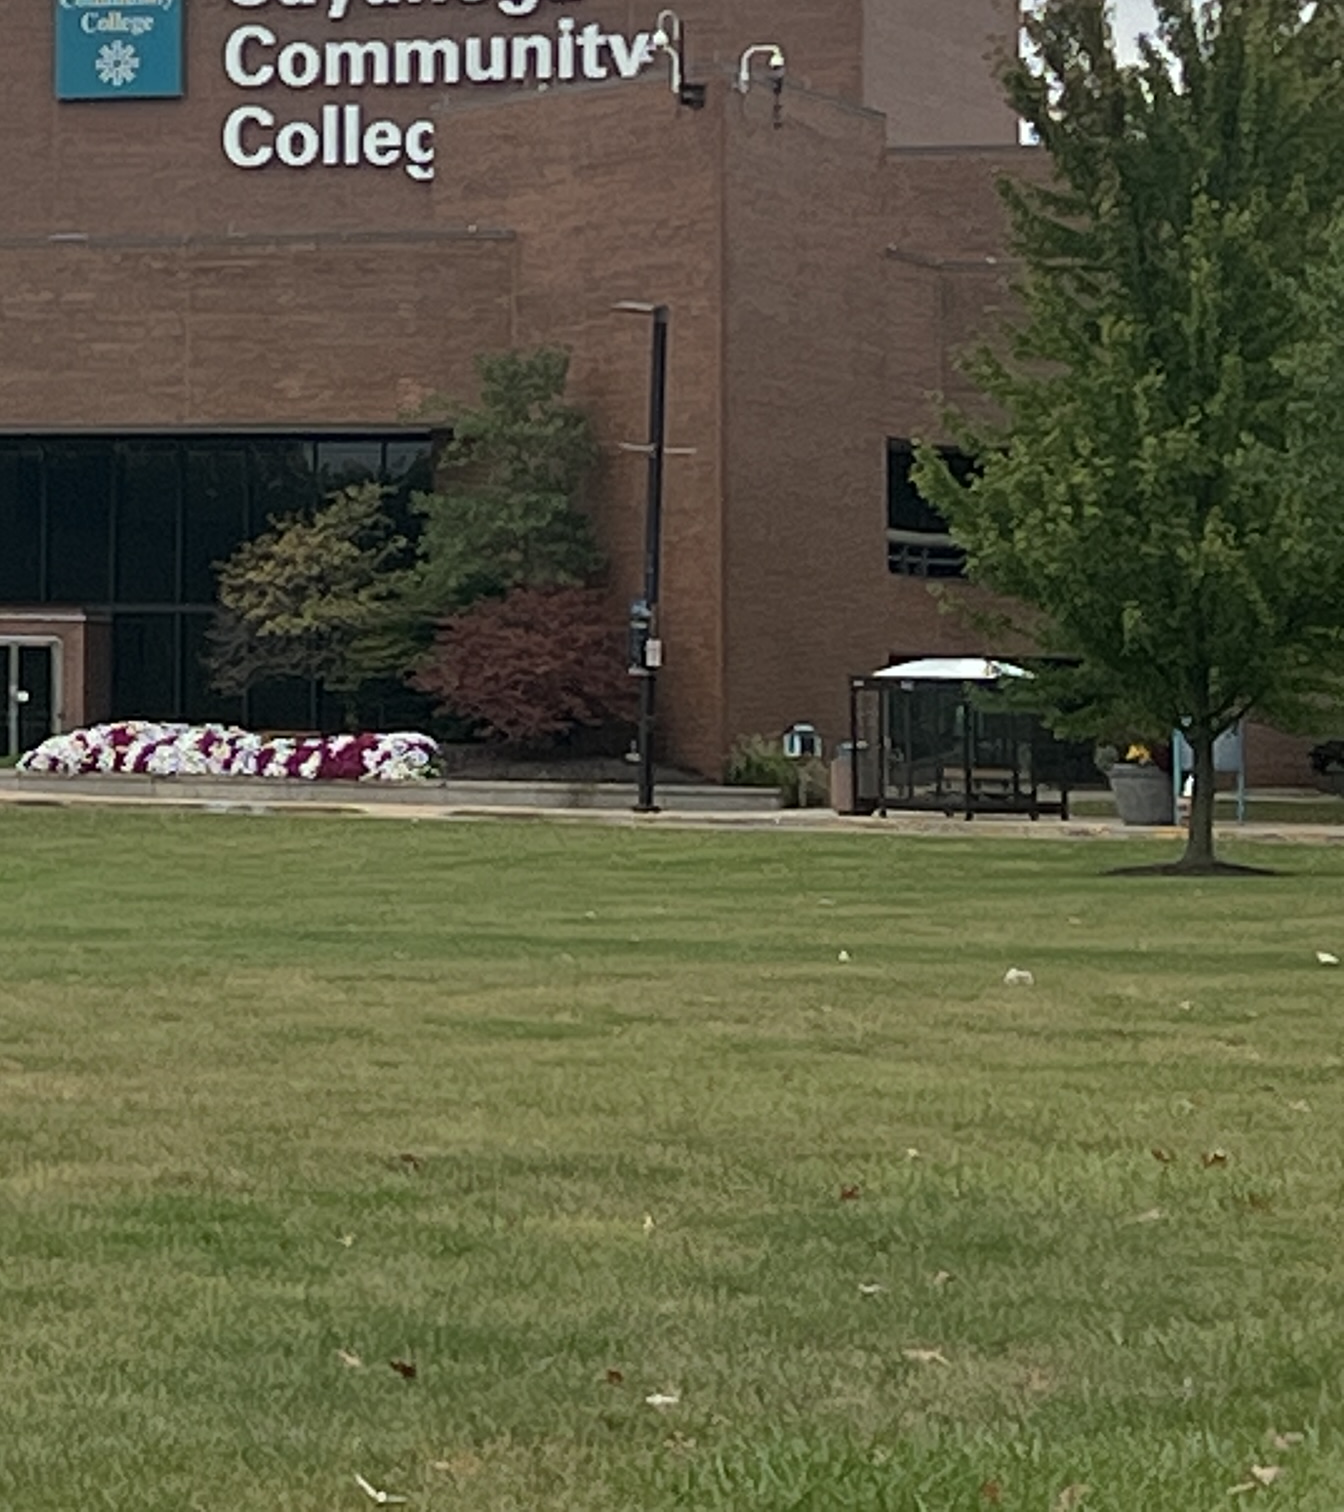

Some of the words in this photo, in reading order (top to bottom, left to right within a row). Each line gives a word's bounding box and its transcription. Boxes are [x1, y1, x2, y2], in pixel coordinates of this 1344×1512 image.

[80, 10, 154, 35] College
[224, 18, 652, 86] Community
[223, 104, 434, 180] Colleg
